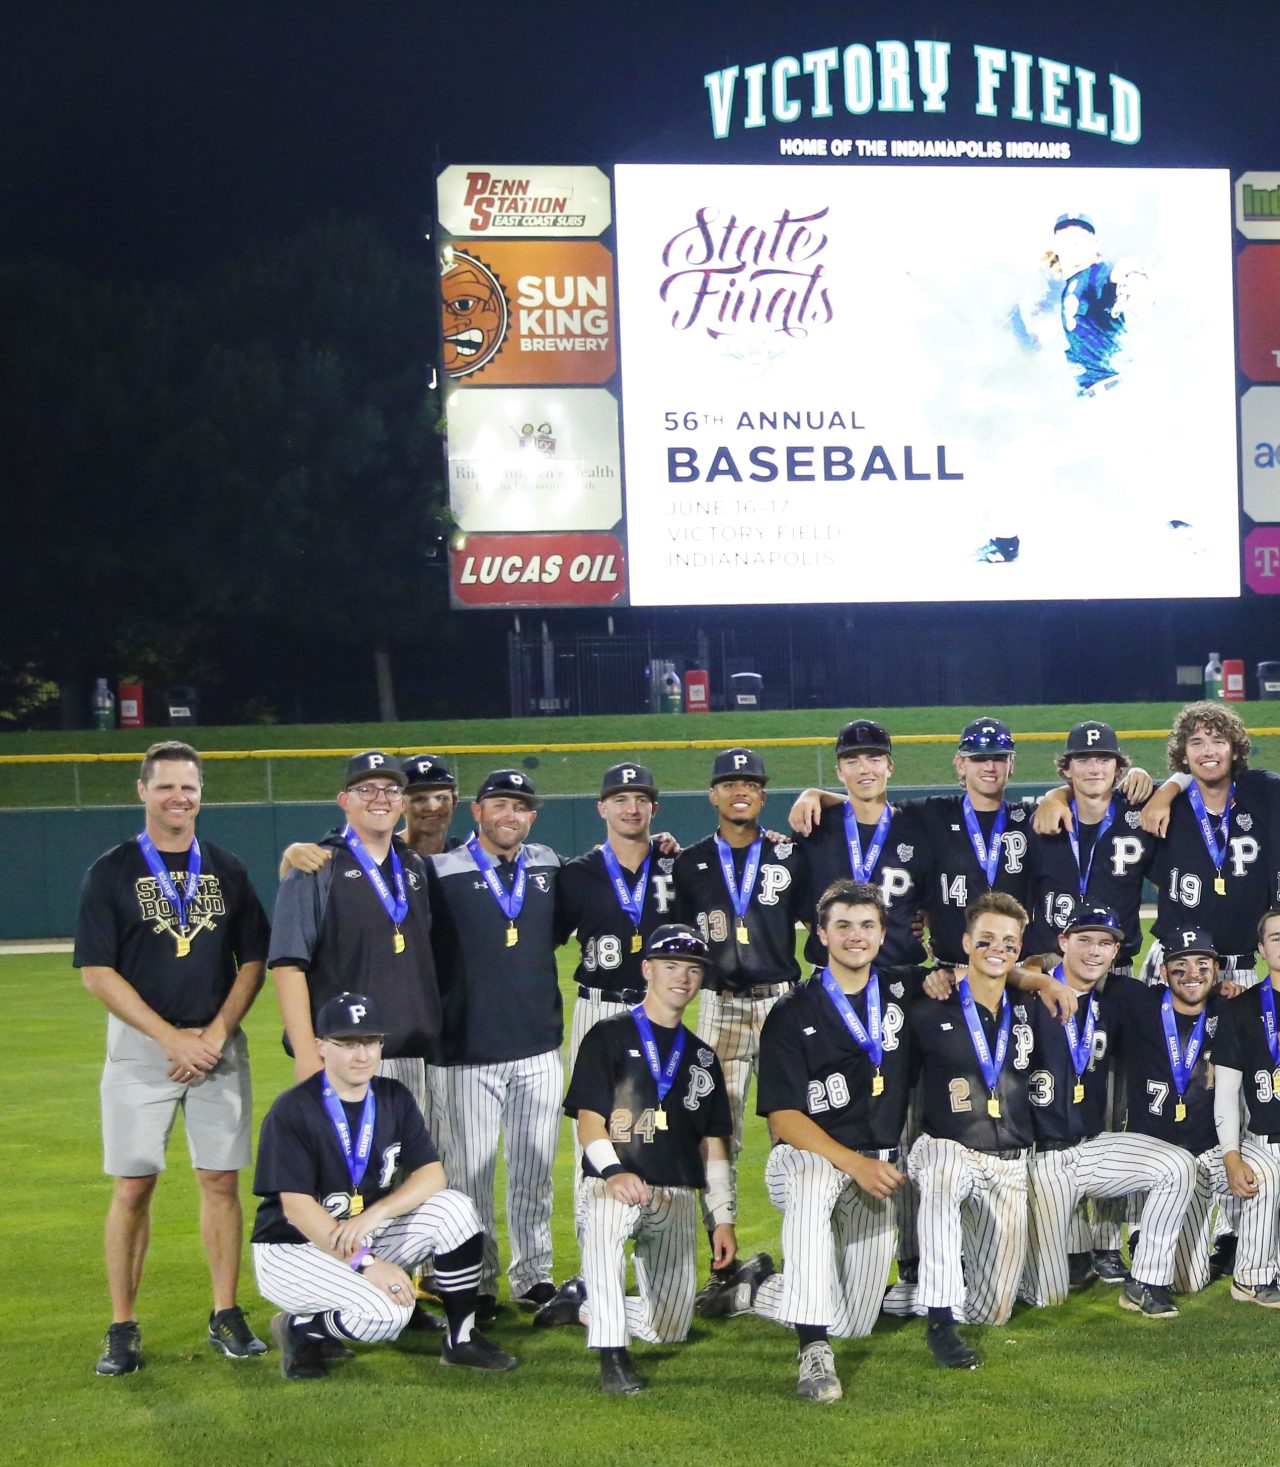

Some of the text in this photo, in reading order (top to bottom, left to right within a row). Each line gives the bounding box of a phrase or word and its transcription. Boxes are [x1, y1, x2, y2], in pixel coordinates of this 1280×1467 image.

[704, 40, 1141, 145] VICTORY FIELD
[780, 138, 1071, 160] HOME OF THE INDIANAPOLIS INDIANS
[494, 215, 584, 227] EAST COAST SUBS
[662, 206, 829, 268] State
[517, 275, 608, 307] SUN
[659, 262, 833, 339] Finals
[519, 309, 609, 335] KING
[520, 338, 609, 351] BREWERY
[736, 411, 866, 430] ANNUAL
[667, 445, 964, 483] BASEBALL
[667, 500, 726, 516] JUNE
[667, 525, 841, 542] VICTORY FIELD
[460, 554, 618, 584] LUCAS OIL
[667, 551, 835, 568] INDIANAPOLIS
[1087, 729, 1101, 746] P
[369, 754, 385, 769] P
[622, 769, 637, 783] P
[734, 754, 748, 769] P
[1001, 830, 1028, 874] P
[1110, 836, 1145, 877] P
[1229, 836, 1261, 877] P
[758, 863, 792, 905] P
[880, 867, 914, 907] P
[941, 873, 968, 907] 14
[1169, 867, 1203, 908] 19
[1045, 891, 1076, 928] 13
[1182, 931, 1197, 947] P
[350, 1004, 367, 1025] P
[882, 1002, 905, 1052] P
[1012, 1023, 1034, 1070] P
[684, 1064, 716, 1111] P
[807, 1071, 851, 1115] 28
[949, 1077, 973, 1113] 2
[1028, 1069, 1055, 1107] 3
[1146, 1079, 1170, 1116] 7
[609, 1107, 656, 1144] 24
